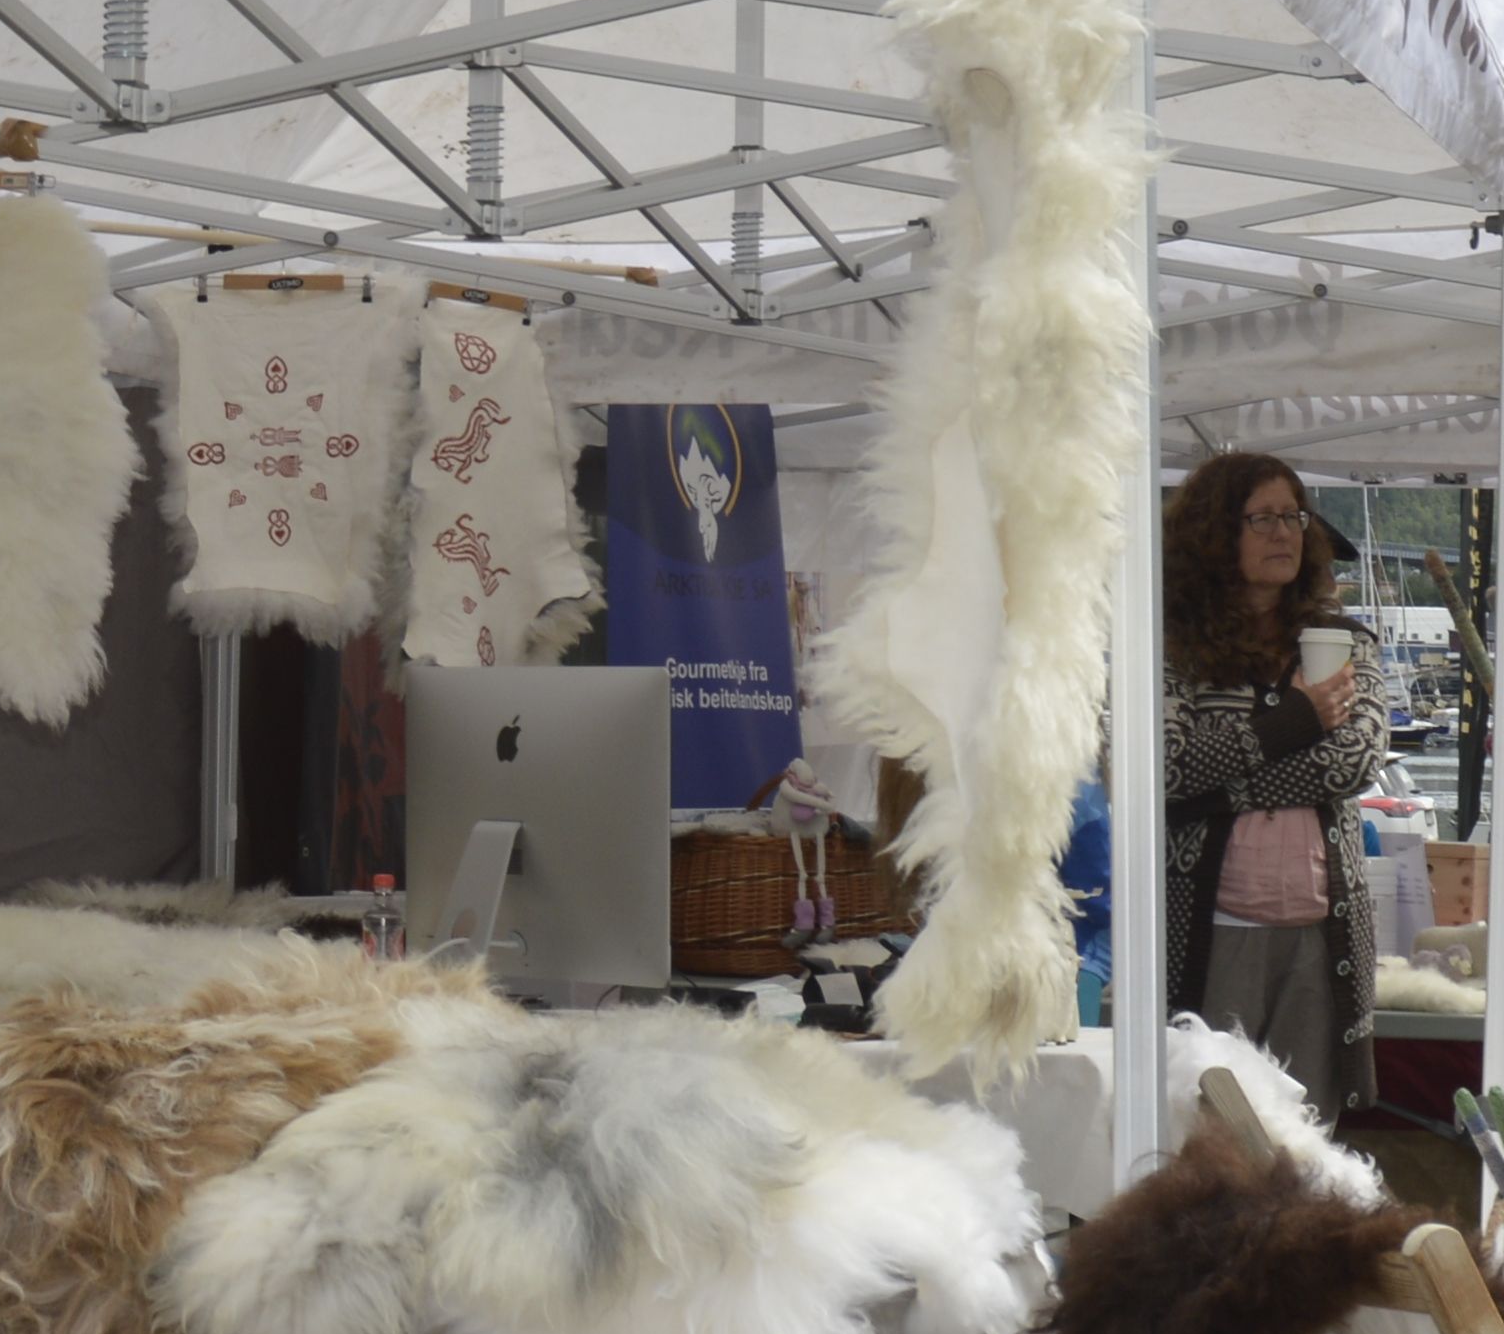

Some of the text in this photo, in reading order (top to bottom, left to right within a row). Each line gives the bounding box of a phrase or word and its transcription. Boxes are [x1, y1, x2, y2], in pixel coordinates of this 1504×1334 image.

[665, 657, 768, 685] Gourmetkje fra
[699, 688, 793, 715] beitelandskap
